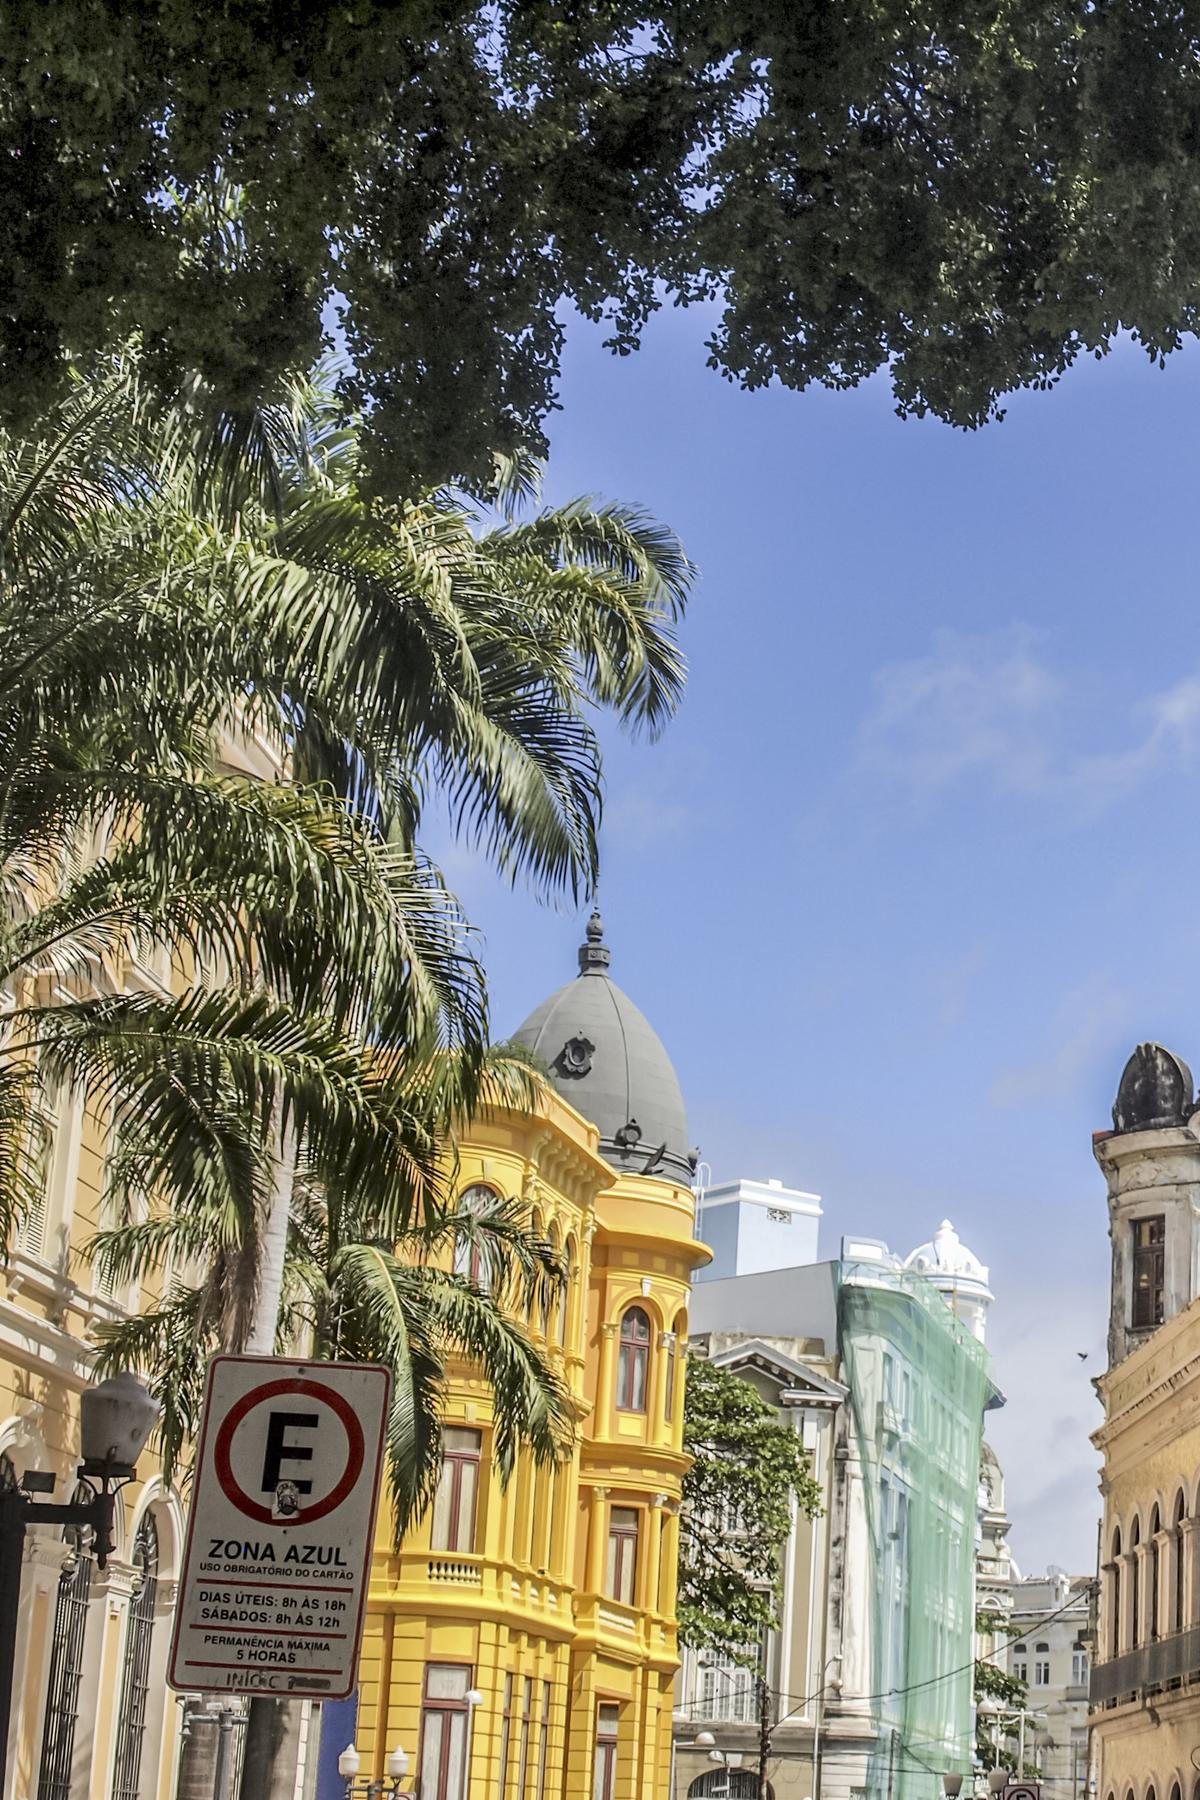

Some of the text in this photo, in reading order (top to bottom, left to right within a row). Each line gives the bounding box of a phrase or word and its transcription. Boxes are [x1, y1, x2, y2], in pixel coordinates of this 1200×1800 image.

[262, 1412, 319, 1494] E
[208, 1539, 347, 1566] ZONA AZUL
[200, 1563, 221, 1572] USO
[295, 1570, 310, 1578] DO
[312, 1569, 354, 1580] CARTÃO
[200, 1591, 231, 1604] DIAS
[235, 1591, 278, 1607] ÚTEIS:
[282, 1597, 298, 1608] 8h
[324, 1600, 346, 1611] 18h
[201, 1605, 272, 1623] SÁBADOS:
[275, 1613, 292, 1624] 8h
[318, 1616, 340, 1628] 12h
[204, 1635, 331, 1651] PERMANÊNCIA MÁXIMA
[236, 1650, 297, 1664] 5 HORAS
